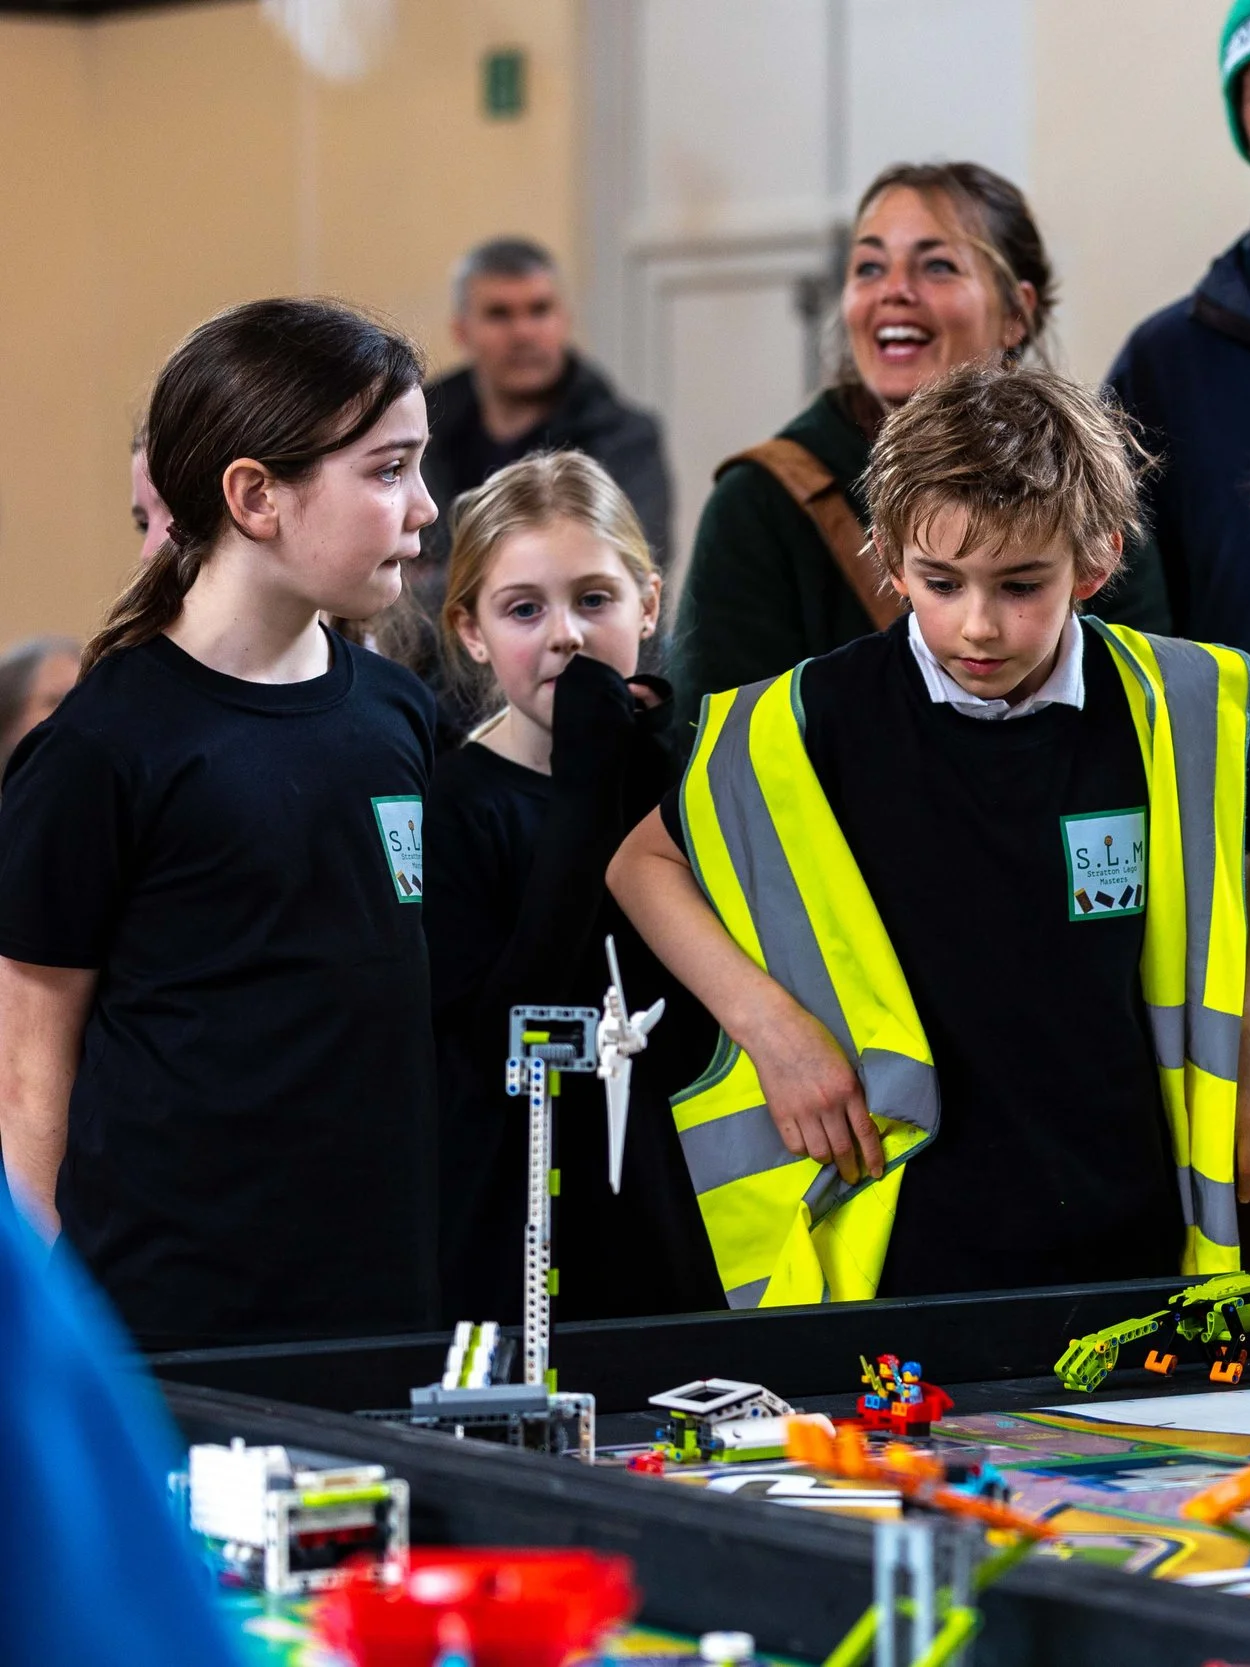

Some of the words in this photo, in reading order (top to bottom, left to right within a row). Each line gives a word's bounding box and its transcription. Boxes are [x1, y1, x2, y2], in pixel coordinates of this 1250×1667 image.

[1076, 841, 1143, 869] S.L.M
[1087, 868, 1120, 877] Stratton
[1123, 865, 1137, 873] Lego
[1100, 877, 1128, 885] Masters
